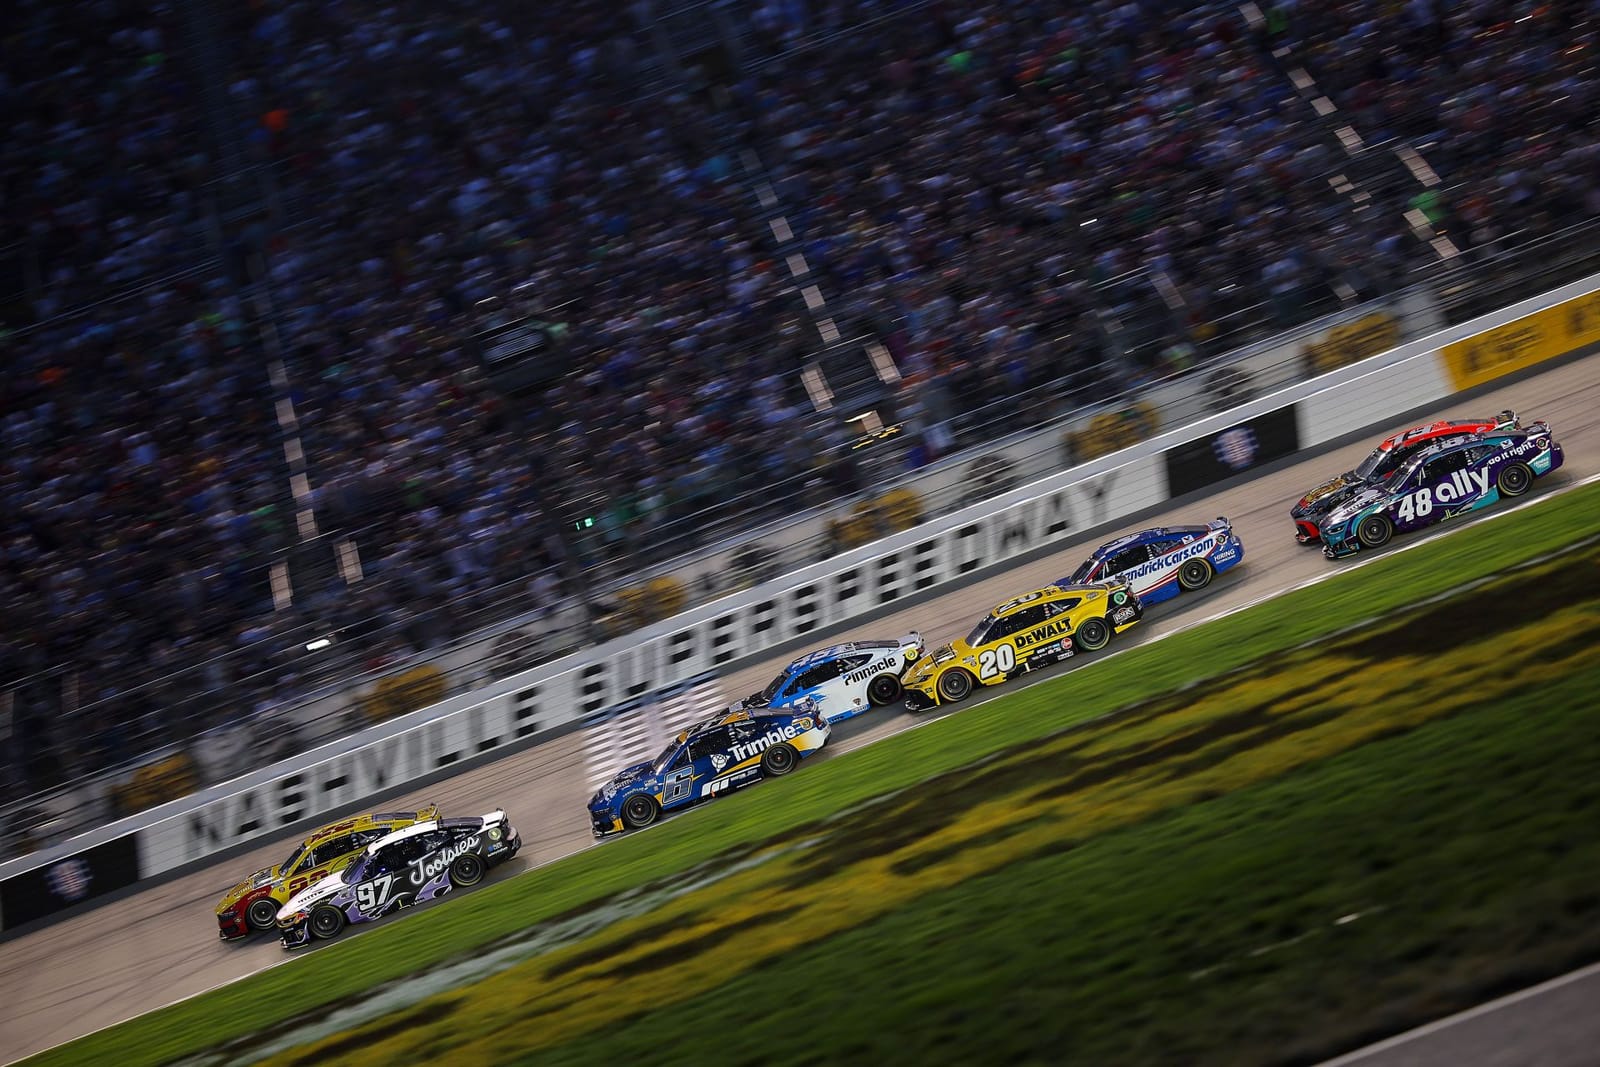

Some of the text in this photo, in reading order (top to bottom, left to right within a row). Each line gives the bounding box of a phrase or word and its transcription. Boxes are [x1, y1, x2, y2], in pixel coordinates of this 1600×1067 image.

[1509, 440, 1536, 457] right.
[1398, 466, 1489, 523] 48 ally
[1118, 537, 1214, 581] endrickCars.com
[186, 468, 1121, 860] NASHVILLE SUPERSPEEDWAY
[842, 657, 897, 686] Pinnacle
[979, 643, 1017, 681] 20
[662, 764, 695, 804] 6
[407, 836, 480, 885] Tootsies
[356, 874, 393, 912] 97
